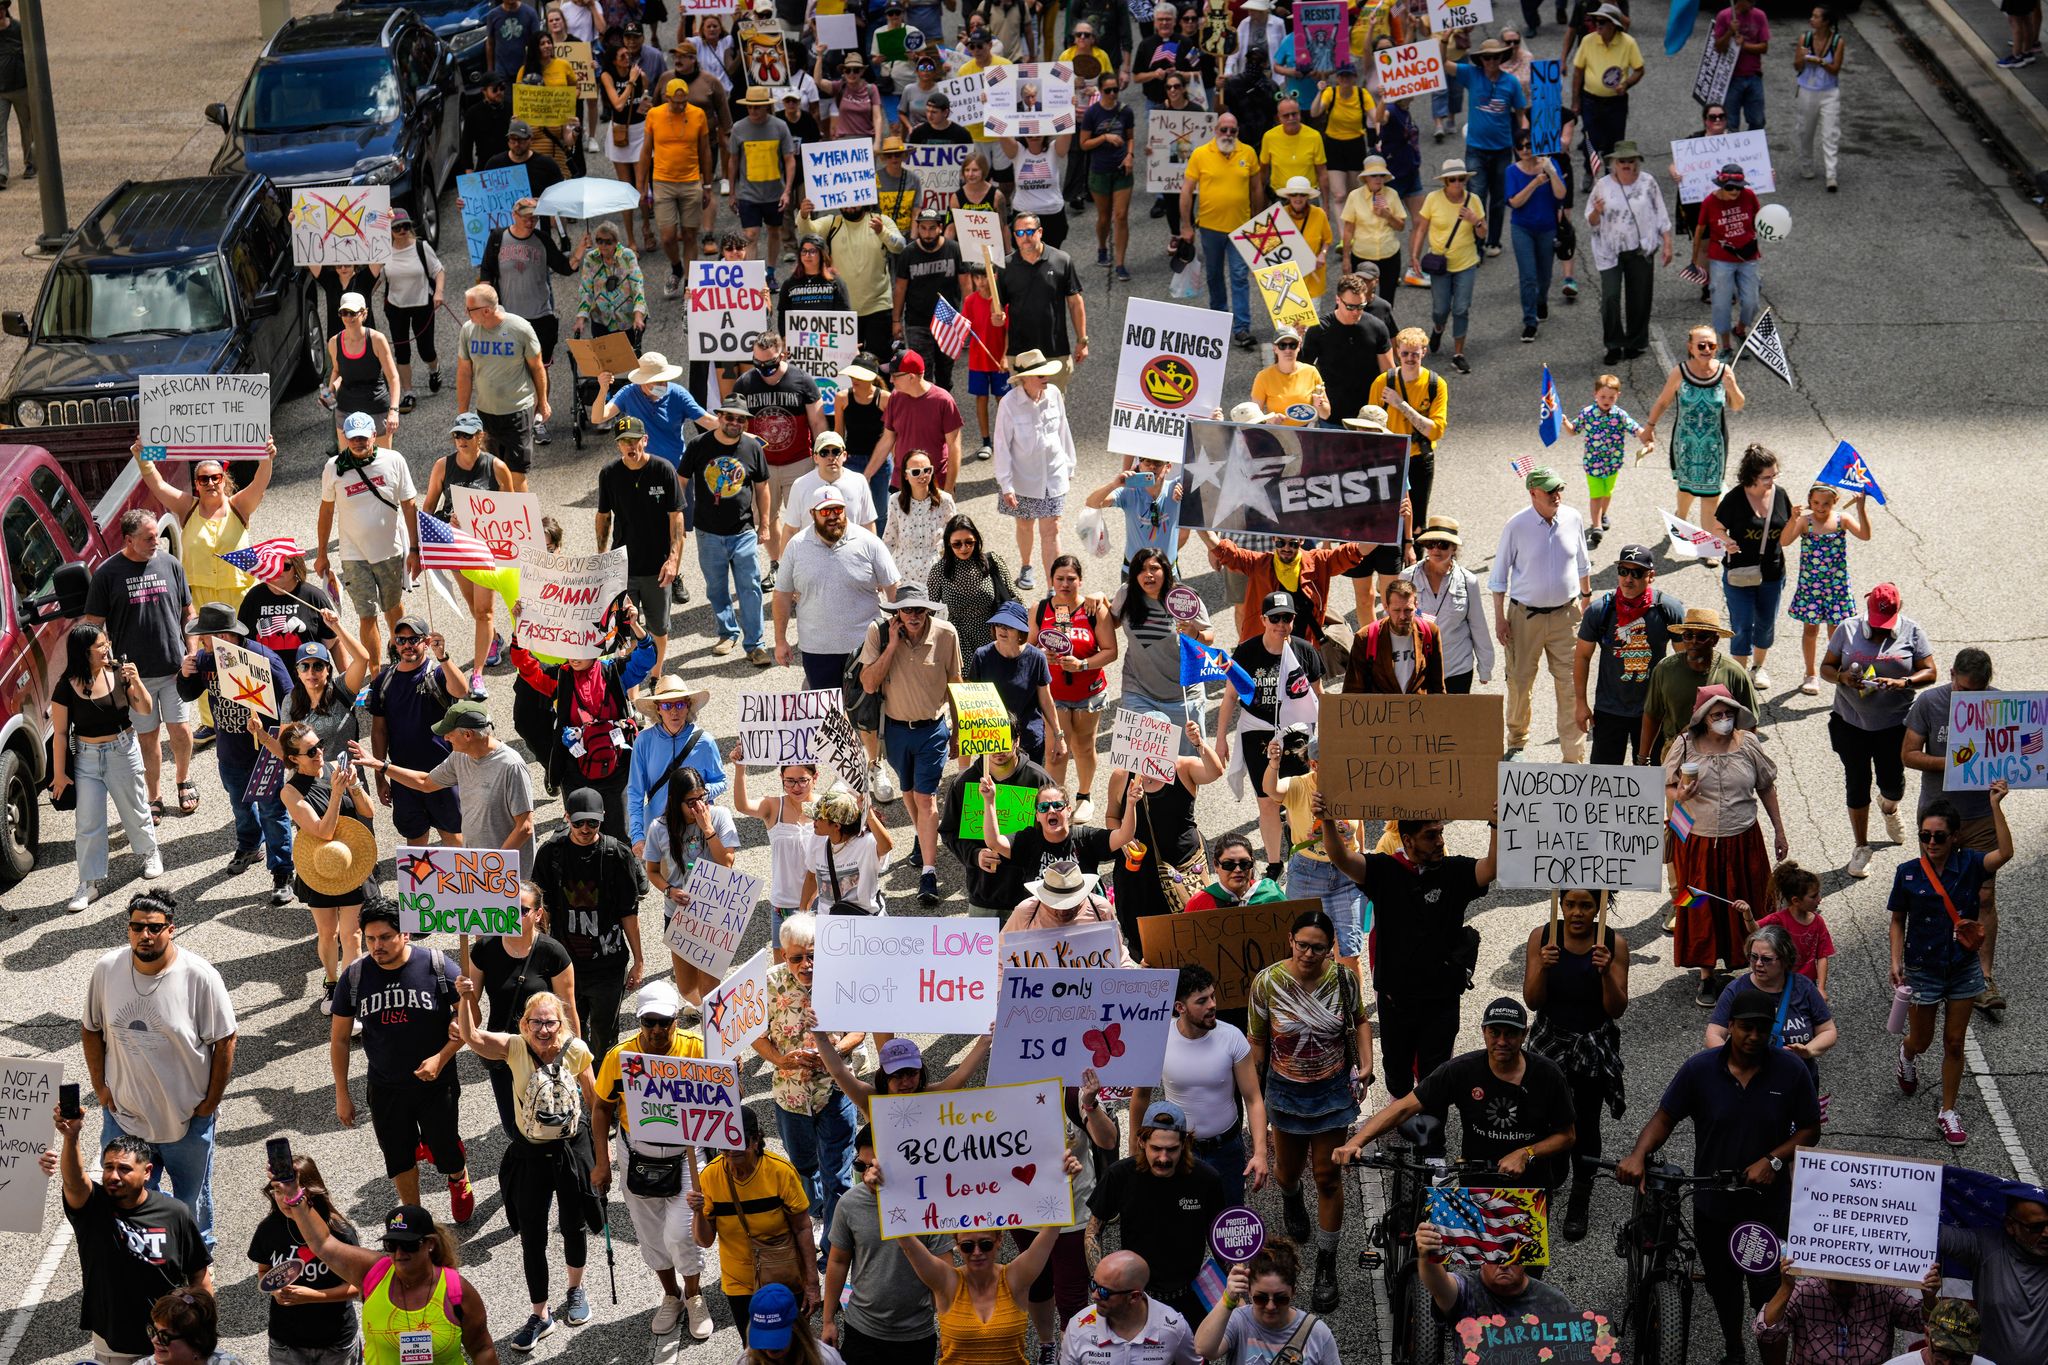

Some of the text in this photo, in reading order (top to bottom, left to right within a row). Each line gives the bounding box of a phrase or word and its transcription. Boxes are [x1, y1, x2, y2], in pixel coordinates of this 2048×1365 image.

[1304, 8, 1336, 21] RESIST
[1442, 14, 1478, 29] KINGS
[1450, 6, 1467, 16] NO
[1397, 46, 1418, 62] NO
[1382, 57, 1439, 83] MANGO
[1531, 61, 1560, 84] NO
[1532, 130, 1559, 153] WAY
[809, 148, 869, 168] WHEN ARE
[821, 187, 871, 207] THIS ICE
[965, 214, 988, 224] TAX
[1757, 219, 1774, 235] NO
[968, 229, 991, 239] THE
[296, 231, 325, 263] NO
[909, 259, 955, 279] PANTERA
[721, 311, 735, 330] A
[789, 316, 854, 336] NO ONE IS
[471, 340, 515, 356] DUKE
[799, 332, 838, 348] FREE
[1126, 324, 1223, 360] NO KINGS
[787, 346, 823, 361] WHEN
[94, 381, 115, 389] Jeep
[143, 376, 270, 405] AMERICAN PATRIOT
[170, 401, 245, 416] PROTECT THE
[747, 391, 800, 408] REVOLUTION
[619, 420, 631, 430] 21
[1113, 408, 1132, 427] IN
[150, 422, 267, 444] CONSTITUTION
[469, 495, 496, 516] NO
[471, 504, 532, 541] Kings!
[520, 546, 586, 573] SHADOW
[261, 604, 299, 616] RESIST
[572, 606, 604, 621] FILES
[560, 629, 597, 647] SCUM
[238, 650, 271, 684] NO KINGS
[962, 684, 988, 692] WHEN
[1263, 687, 1273, 696] BY
[742, 695, 777, 723] BAN
[964, 708, 1002, 720] NORMAL
[1340, 699, 1427, 729] POWER
[958, 718, 1010, 730] COMPASSION
[1118, 710, 1171, 734] THE POWER
[740, 730, 773, 760] NOT
[971, 729, 1000, 740] LOOKS
[1128, 726, 1168, 744] TO THE
[1369, 734, 1457, 755] TO THE
[1985, 725, 2019, 757] NOT
[961, 738, 1009, 756] RADICAL
[1130, 737, 1168, 757] PEOPLE
[1110, 752, 1138, 770] NOT A
[1963, 752, 2032, 786] KINGS
[1347, 758, 1464, 798] PEOPLE!!
[1503, 770, 1640, 799] NOBODY PAID
[1360, 805, 1386, 818] THE
[1502, 802, 1660, 825] ME TO BE HERE
[1504, 829, 1589, 851] I HATE
[454, 851, 505, 873] NO
[1534, 855, 1636, 886] FOR FREE
[437, 870, 520, 898] KINGS
[694, 861, 756, 894] ALL MY
[399, 892, 435, 911] NO
[689, 879, 751, 915] HOMIES
[419, 906, 522, 935] DICTATOR
[721, 913, 747, 934] AN
[1172, 911, 1297, 949] FASCISM
[671, 911, 735, 954] APOLITICAL
[821, 919, 993, 957] Choose Love
[669, 930, 716, 967] BITCH
[1217, 937, 1265, 982] NO
[732, 978, 755, 1014] NO
[835, 968, 985, 1004] Not Hate
[1008, 977, 1170, 1000] The only Orange
[360, 989, 433, 1018] ADIDAS
[1100, 1000, 1171, 1021] I Want
[381, 1008, 409, 1025] USA
[719, 988, 765, 1056] KINGS
[1051, 1036, 1067, 1057] a
[4, 1069, 49, 1089] NOT A
[650, 1060, 735, 1087] NO KINGS
[643, 1079, 734, 1108] AMERICA
[641, 1101, 743, 1147] SINCE 1776
[937, 1101, 998, 1126] Here
[0, 1139, 48, 1154] WRONG
[897, 1129, 1032, 1166] BECAUSE
[1800, 1156, 1936, 1183] THE CONSTITUTION
[914, 1173, 1001, 1200] I Love
[1179, 1198, 1194, 1206] give
[1832, 1193, 1918, 1212] PERSON SHALL
[922, 1202, 1023, 1230] America
[1226, 1217, 1248, 1226] PROTECT
[1833, 1208, 1909, 1226] BE DEPRIVED
[1216, 1223, 1261, 1239] IMMIGRANT
[1224, 1235, 1253, 1248] RIGHTS
[1813, 1222, 1911, 1244] OF LIFE, LIBERTY,
[1737, 1232, 1750, 1254] PROTECT
[1741, 1226, 1762, 1267] IMMIGRANT
[1752, 1236, 1769, 1265] RIGHTS
[1789, 1234, 1937, 1261] OR PROPERTY, WITHOUT
[266, 1262, 293, 1279] COMMIT
[1792, 1251, 1890, 1271] DUE PROCESS OF
[411, 1335, 431, 1343] KINGS
[1485, 1321, 1596, 1348] KAROLINE
